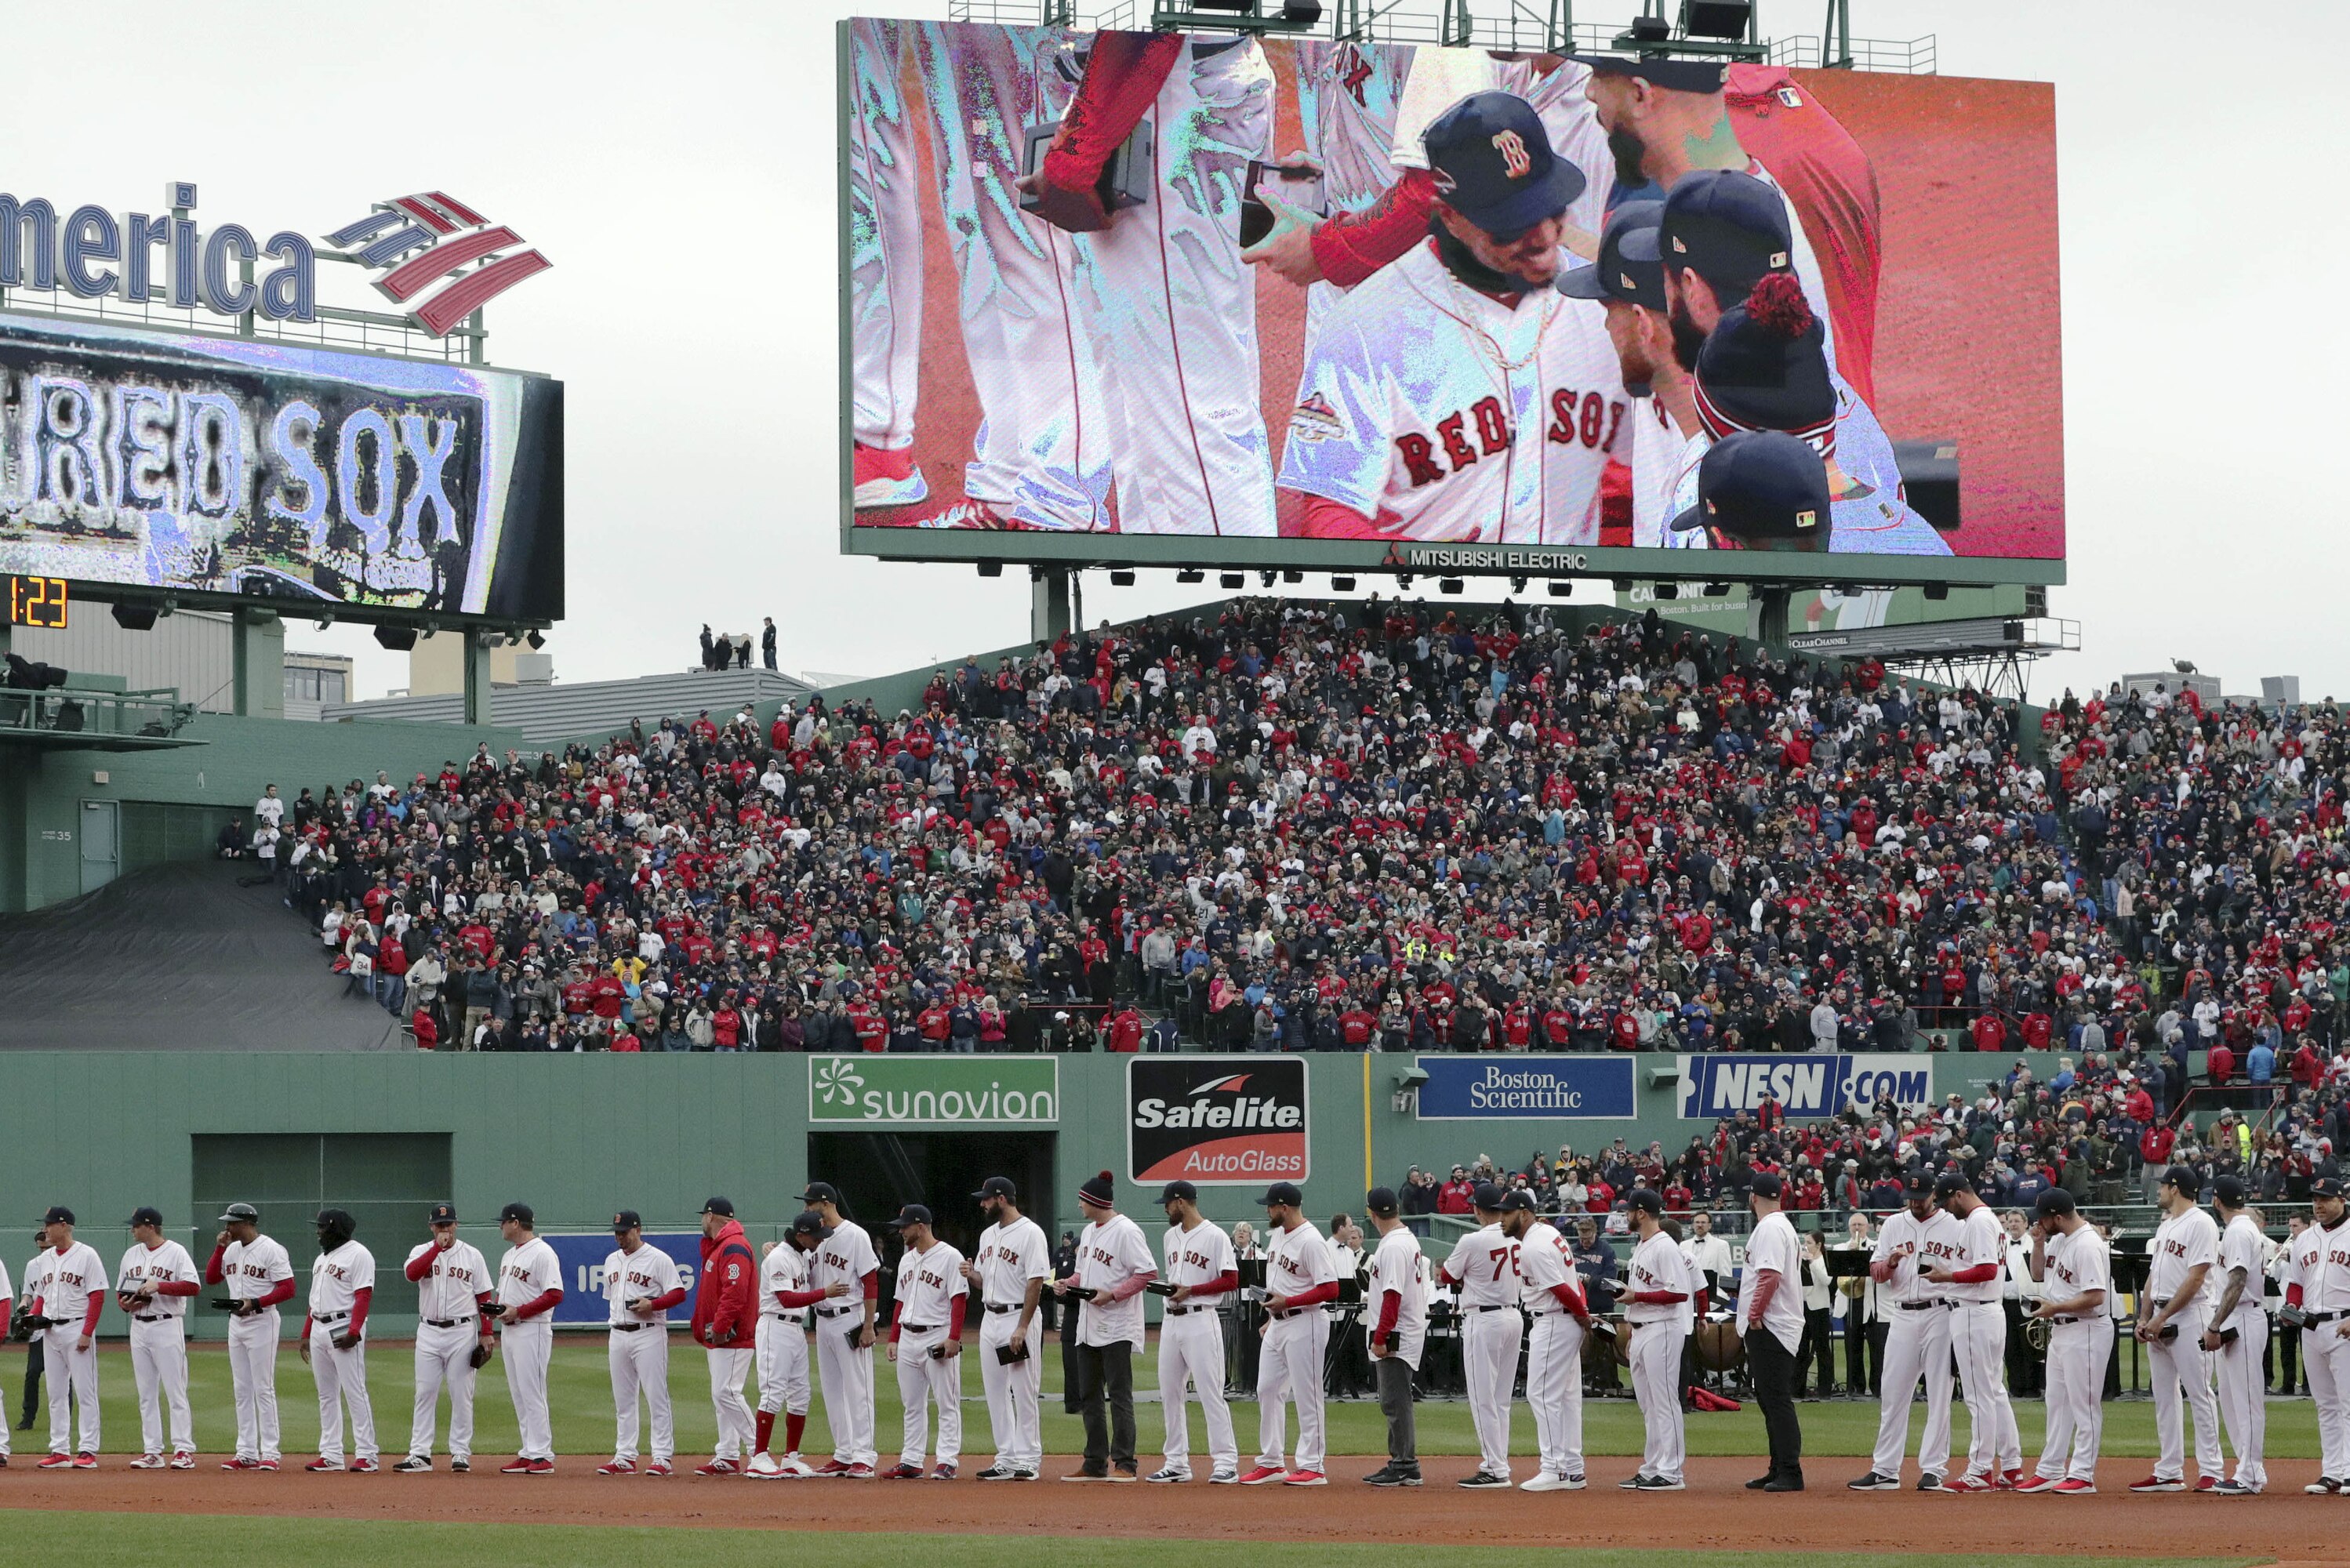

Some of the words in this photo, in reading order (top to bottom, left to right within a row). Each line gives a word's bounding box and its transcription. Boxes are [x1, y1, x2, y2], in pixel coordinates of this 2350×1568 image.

[1395, 394, 1512, 488] RED
[31, 375, 242, 521] RED
[270, 400, 461, 549] SOX
[1411, 550, 1504, 568] MITSUBISHI
[1508, 551, 1588, 571] ELECTRIC
[10, 577, 67, 627] 1:23
[1691, 603, 1710, 612] Built
[1711, 601, 1722, 611] for
[1485, 1065, 1556, 1090] Boston
[1713, 1063, 1826, 1109] NESN
[863, 1082, 1053, 1120] sunovion
[1469, 1081, 1582, 1110] Scientific
[1134, 1098, 1300, 1129] Safelite
[1183, 1149, 1302, 1174] AutoGlass
[997, 1246, 1020, 1266] SOX
[1092, 1247, 1115, 1267] SOX
[1184, 1250, 1211, 1270] SOX
[1552, 1234, 1574, 1268] 5
[1925, 1240, 1954, 1260] SOX
[243, 1264, 267, 1279] SOX
[728, 1263, 740, 1280] B
[824, 1252, 849, 1271] SOX
[1277, 1254, 1299, 1275] SOX
[60, 1271, 84, 1287] SOX
[150, 1265, 174, 1282] SOX
[448, 1266, 473, 1283] SOX
[510, 1265, 532, 1283] SOX
[627, 1271, 652, 1288] SOX
[919, 1269, 944, 1290] SOX
